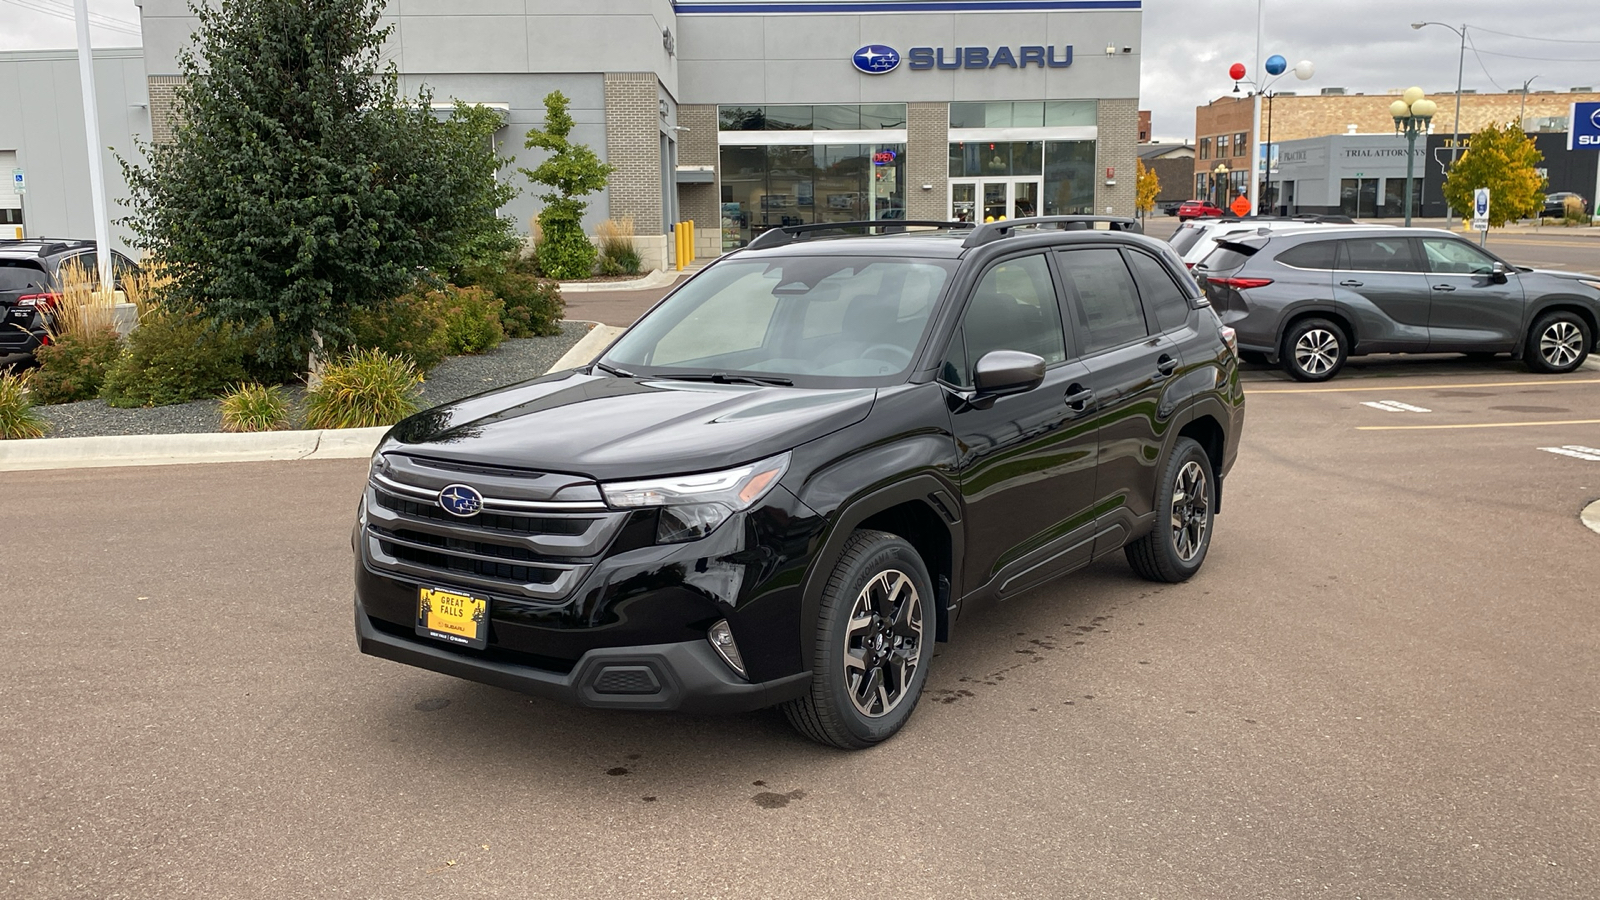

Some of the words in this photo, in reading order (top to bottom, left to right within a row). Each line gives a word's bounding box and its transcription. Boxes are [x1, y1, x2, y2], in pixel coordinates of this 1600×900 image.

[908, 45, 1073, 70] SUBARU
[873, 152, 894, 163] OPEN
[1284, 150, 1307, 162] PRACTICE
[1345, 149, 1373, 157] TRIAL
[1374, 149, 1426, 157] ATTORNYS
[853, 551, 890, 591] YOKOHAMA
[441, 596, 464, 608] GREAT
[440, 605, 464, 618] FALLS
[444, 623, 465, 632] SUBARU
